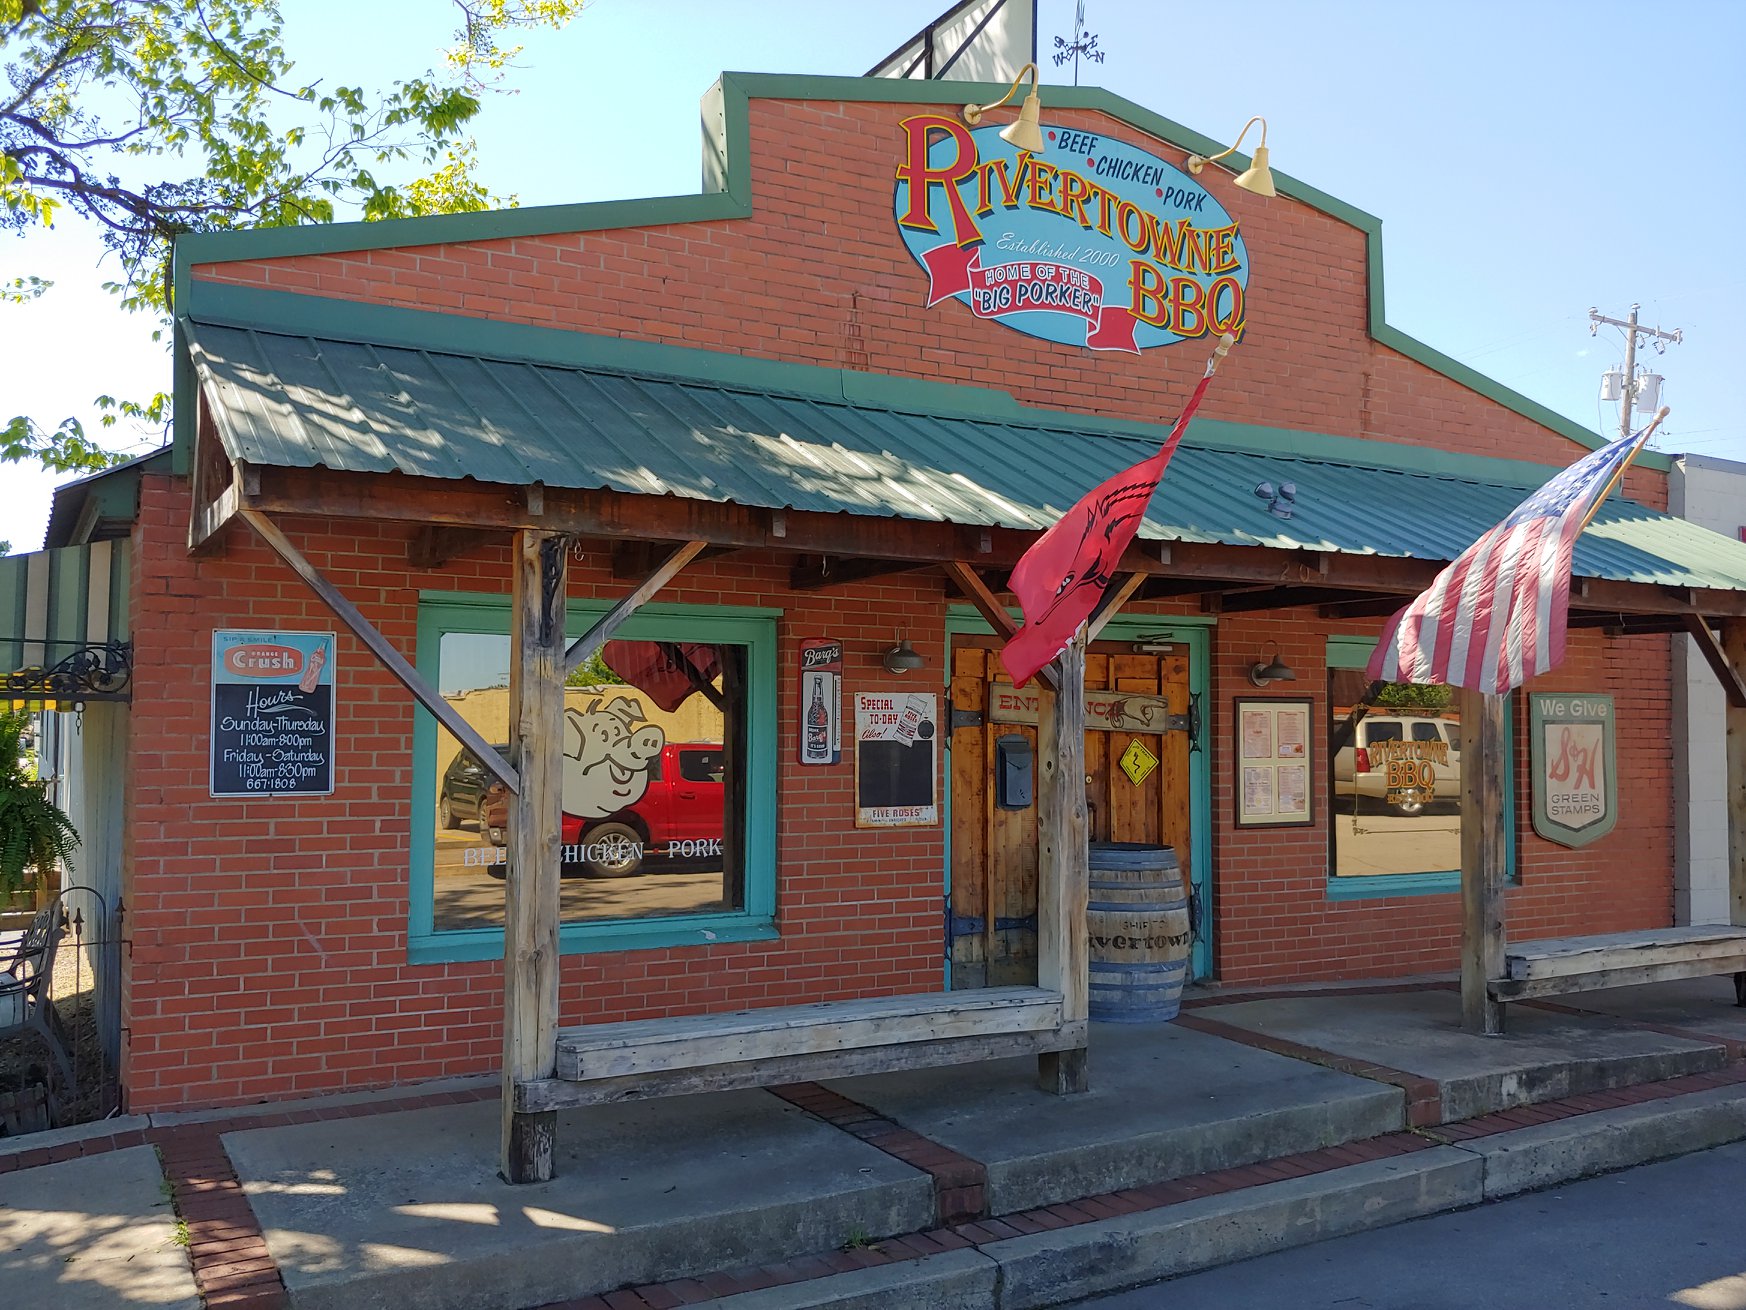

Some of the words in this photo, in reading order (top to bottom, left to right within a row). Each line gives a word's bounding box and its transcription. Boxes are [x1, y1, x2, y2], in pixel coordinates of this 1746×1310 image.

[1052, 51, 1064, 67] W
[1095, 50, 1105, 64] N
[1057, 131, 1099, 156] BEEF
[1096, 156, 1165, 186] CHICKEN
[896, 115, 1239, 275] RIVERTOWNE
[1162, 186, 1207, 212] PORK
[996, 232, 1080, 260] Established
[1079, 248, 1120, 267] 2000
[985, 265, 1031, 286] HOME
[1036, 266, 1055, 279] OF
[1060, 267, 1089, 288] THE
[1127, 260, 1247, 341] BBQ
[232, 650, 294, 669] Crush
[246, 686, 304, 718] Hours
[861, 696, 893, 710] SPECIAL
[1540, 699, 1565, 716] We
[1569, 700, 1607, 716] Give
[1369, 737, 1448, 767] RIVERTOWNE
[1386, 760, 1435, 792] BBQ
[1551, 793, 1599, 804] GREEN
[1551, 804, 1600, 815] STAMPS
[872, 809, 889, 817] FIVE
[893, 808, 920, 818] ROSES
[463, 846, 507, 867] BEE
[561, 841, 645, 863] HICKEN
[668, 838, 722, 859] PORK
